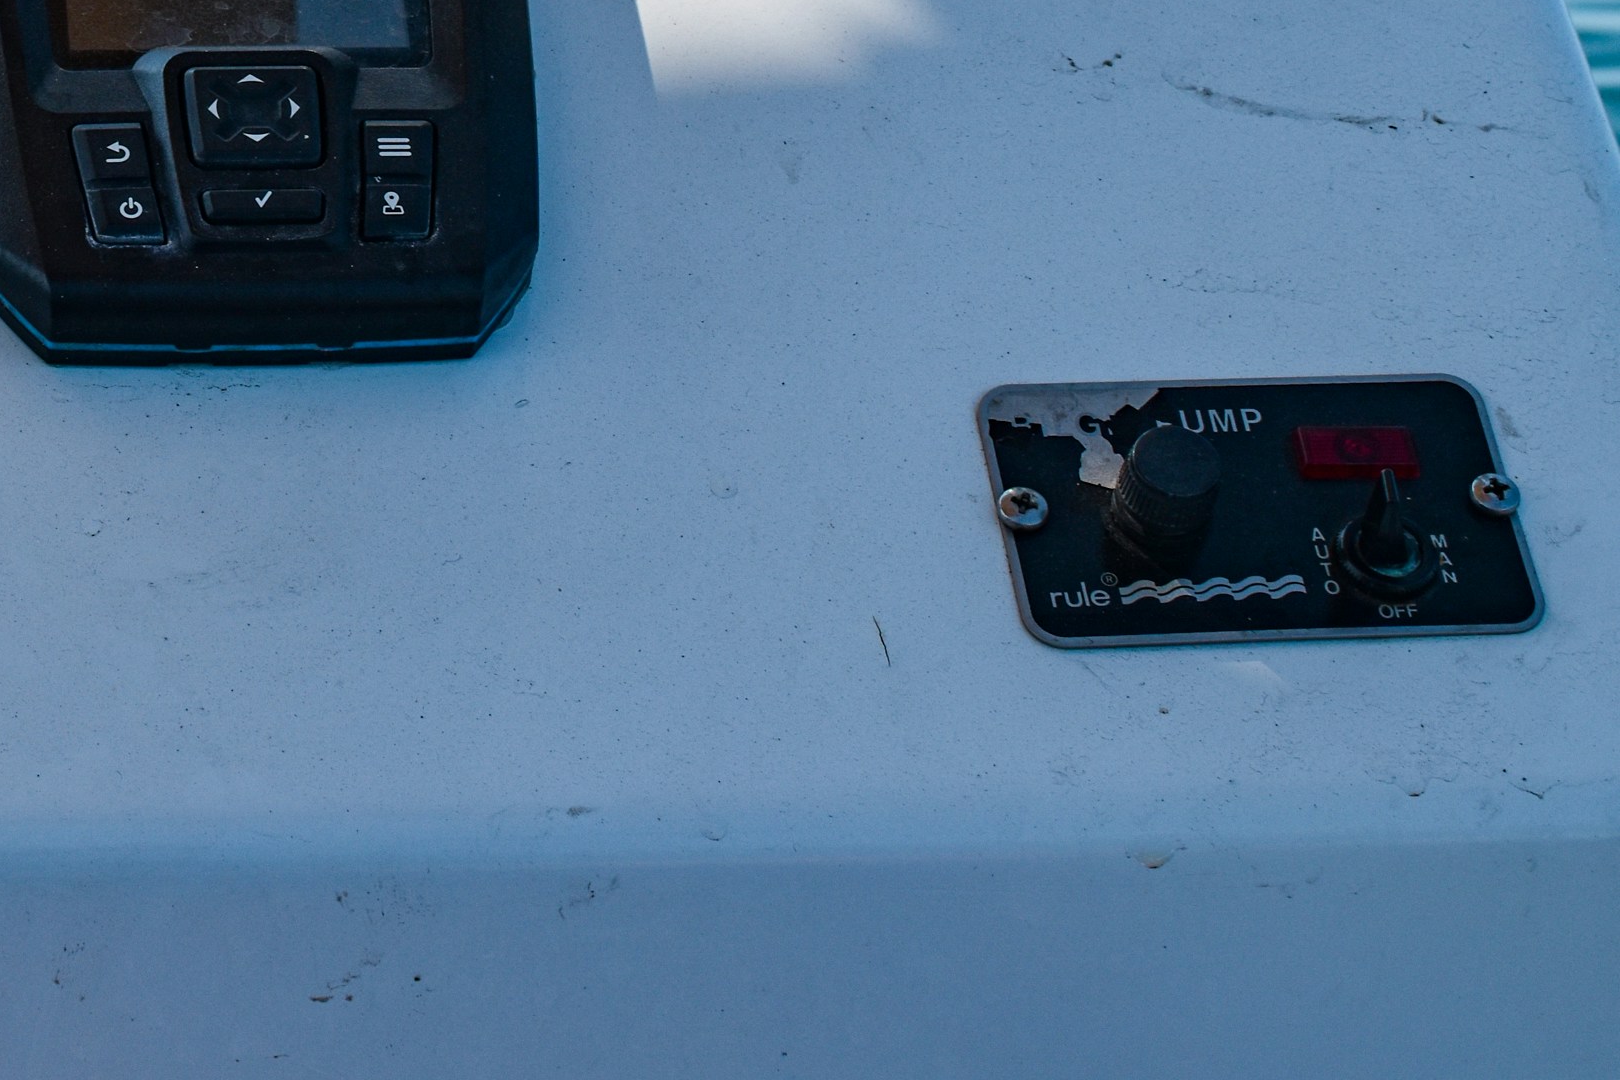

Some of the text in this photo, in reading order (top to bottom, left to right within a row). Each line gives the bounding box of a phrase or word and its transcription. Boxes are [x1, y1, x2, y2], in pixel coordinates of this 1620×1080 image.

[1155, 407, 1262, 434] UMP
[1311, 527, 1341, 595] AUTO
[1430, 533, 1458, 584] MAN
[1378, 603, 1418, 619] OFF
